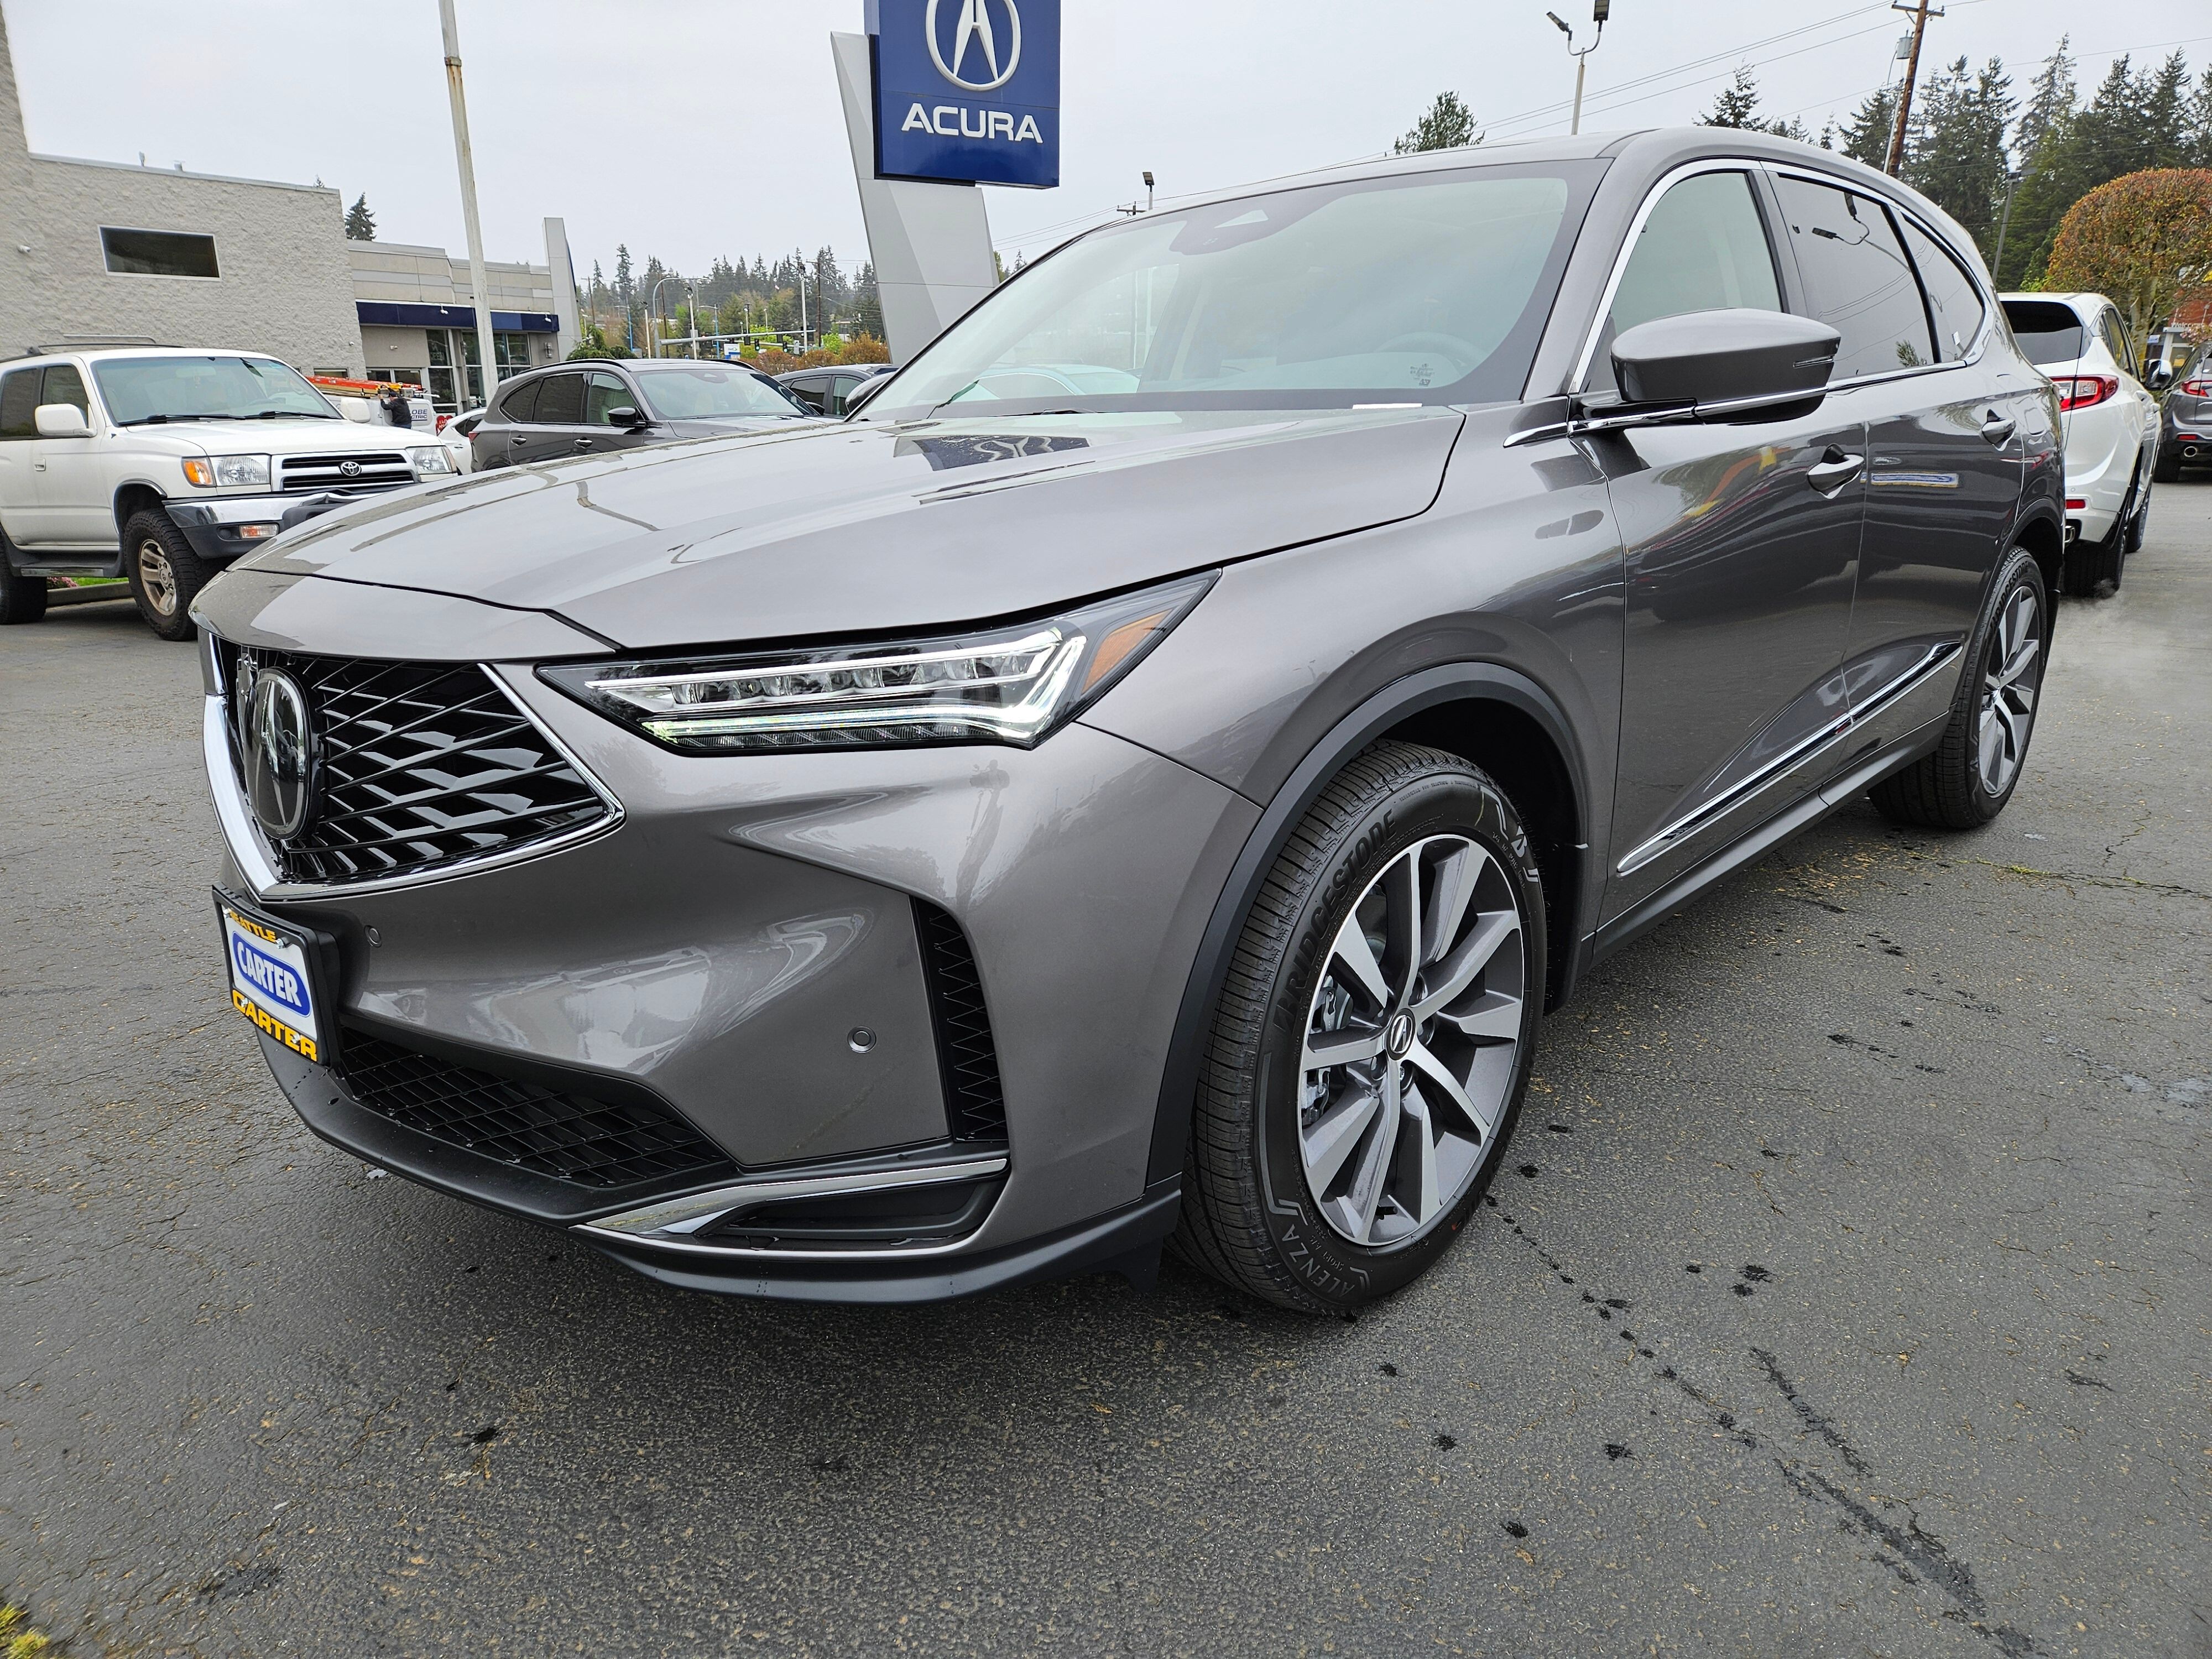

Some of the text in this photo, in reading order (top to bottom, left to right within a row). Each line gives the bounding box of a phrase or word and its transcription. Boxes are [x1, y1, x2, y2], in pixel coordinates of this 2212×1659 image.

[901, 103, 1043, 143] ACURA
[227, 907, 276, 943] SEATTLE
[1272, 808, 1396, 1036] BRIDGESTONE
[237, 941, 302, 1007] CARTER
[232, 989, 317, 1062] CARTER
[1281, 1223, 1355, 1298] ALENZA
[1323, 1251, 1345, 1271] SPORT
